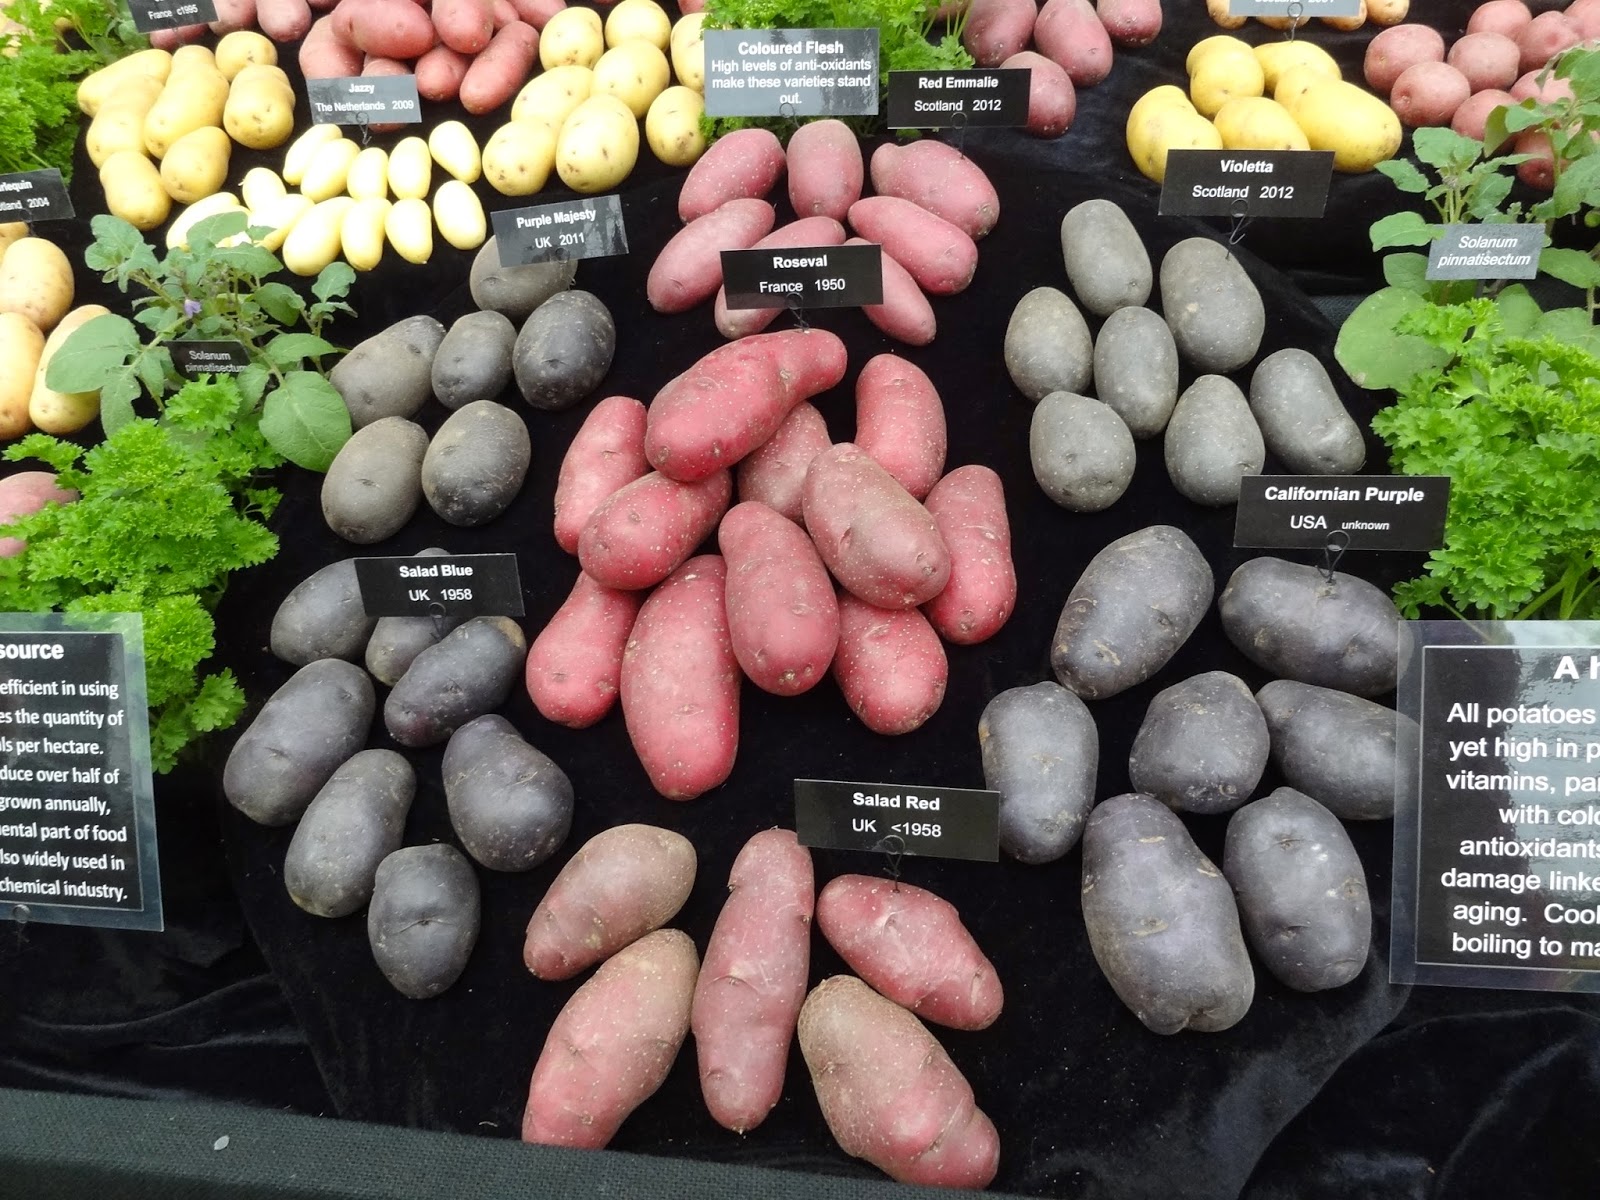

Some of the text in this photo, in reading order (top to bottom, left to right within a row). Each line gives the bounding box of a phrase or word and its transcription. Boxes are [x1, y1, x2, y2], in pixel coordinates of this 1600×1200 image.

[147, 4, 198, 19] France c1995
[738, 41, 844, 55] Coloured Flesh
[711, 58, 872, 75] High levels of anti-oxidants
[349, 83, 375, 94] Jazzy
[712, 74, 871, 88] make these varieties stand
[918, 76, 999, 89] Red Emmalie
[315, 100, 414, 112] The Netherlands 2009
[780, 93, 802, 104] out.
[914, 100, 1002, 112] Scotland 2012
[1220, 159, 1274, 173] Violetta
[0, 180, 33, 193] rlequin
[1192, 185, 1295, 199] Scotland 2012
[0, 197, 50, 212] tland 2004
[516, 209, 597, 229] Purple Majesty
[534, 232, 586, 249] UK 2011
[1458, 235, 1518, 249] Solanum
[773, 254, 828, 269] Roseval
[1437, 253, 1532, 269] pinnatisectum
[759, 278, 846, 293] France 1950
[188, 350, 231, 361] Solanum
[1264, 486, 1425, 505] Californian Purple
[1290, 515, 1390, 531] USA unknown
[399, 564, 474, 578] Salad Blue
[408, 588, 473, 602] UK 1958
[1553, 656, 1580, 680] A
[0, 678, 120, 700] efficient in using
[15, 708, 40, 724] the
[42, 710, 105, 729] quantity
[107, 710, 125, 726] of
[1447, 702, 1597, 728] All potatoes
[16, 741, 41, 756] per
[43, 737, 104, 755] hectare.
[1449, 737, 1488, 762] yet
[1494, 737, 1548, 763] high
[1556, 737, 1578, 758] in
[36, 769, 69, 783] over
[72, 767, 101, 783] half
[103, 768, 120, 785] of
[1446, 770, 1556, 795] vitamins,
[0, 796, 111, 816] grown annually,
[852, 792, 940, 811] Salad Red
[1499, 804, 1549, 825] with
[0, 822, 127, 842] ental part of food
[852, 818, 942, 838] UK <1958
[22, 850, 70, 871] widely
[72, 854, 108, 870] used
[110, 855, 126, 871] in
[0, 876, 128, 903] chemical industry.
[1440, 868, 1541, 895] damage
[1453, 901, 1600, 927] aging. Coo
[1452, 932, 1531, 960] boiling
[1539, 936, 1563, 956] to
